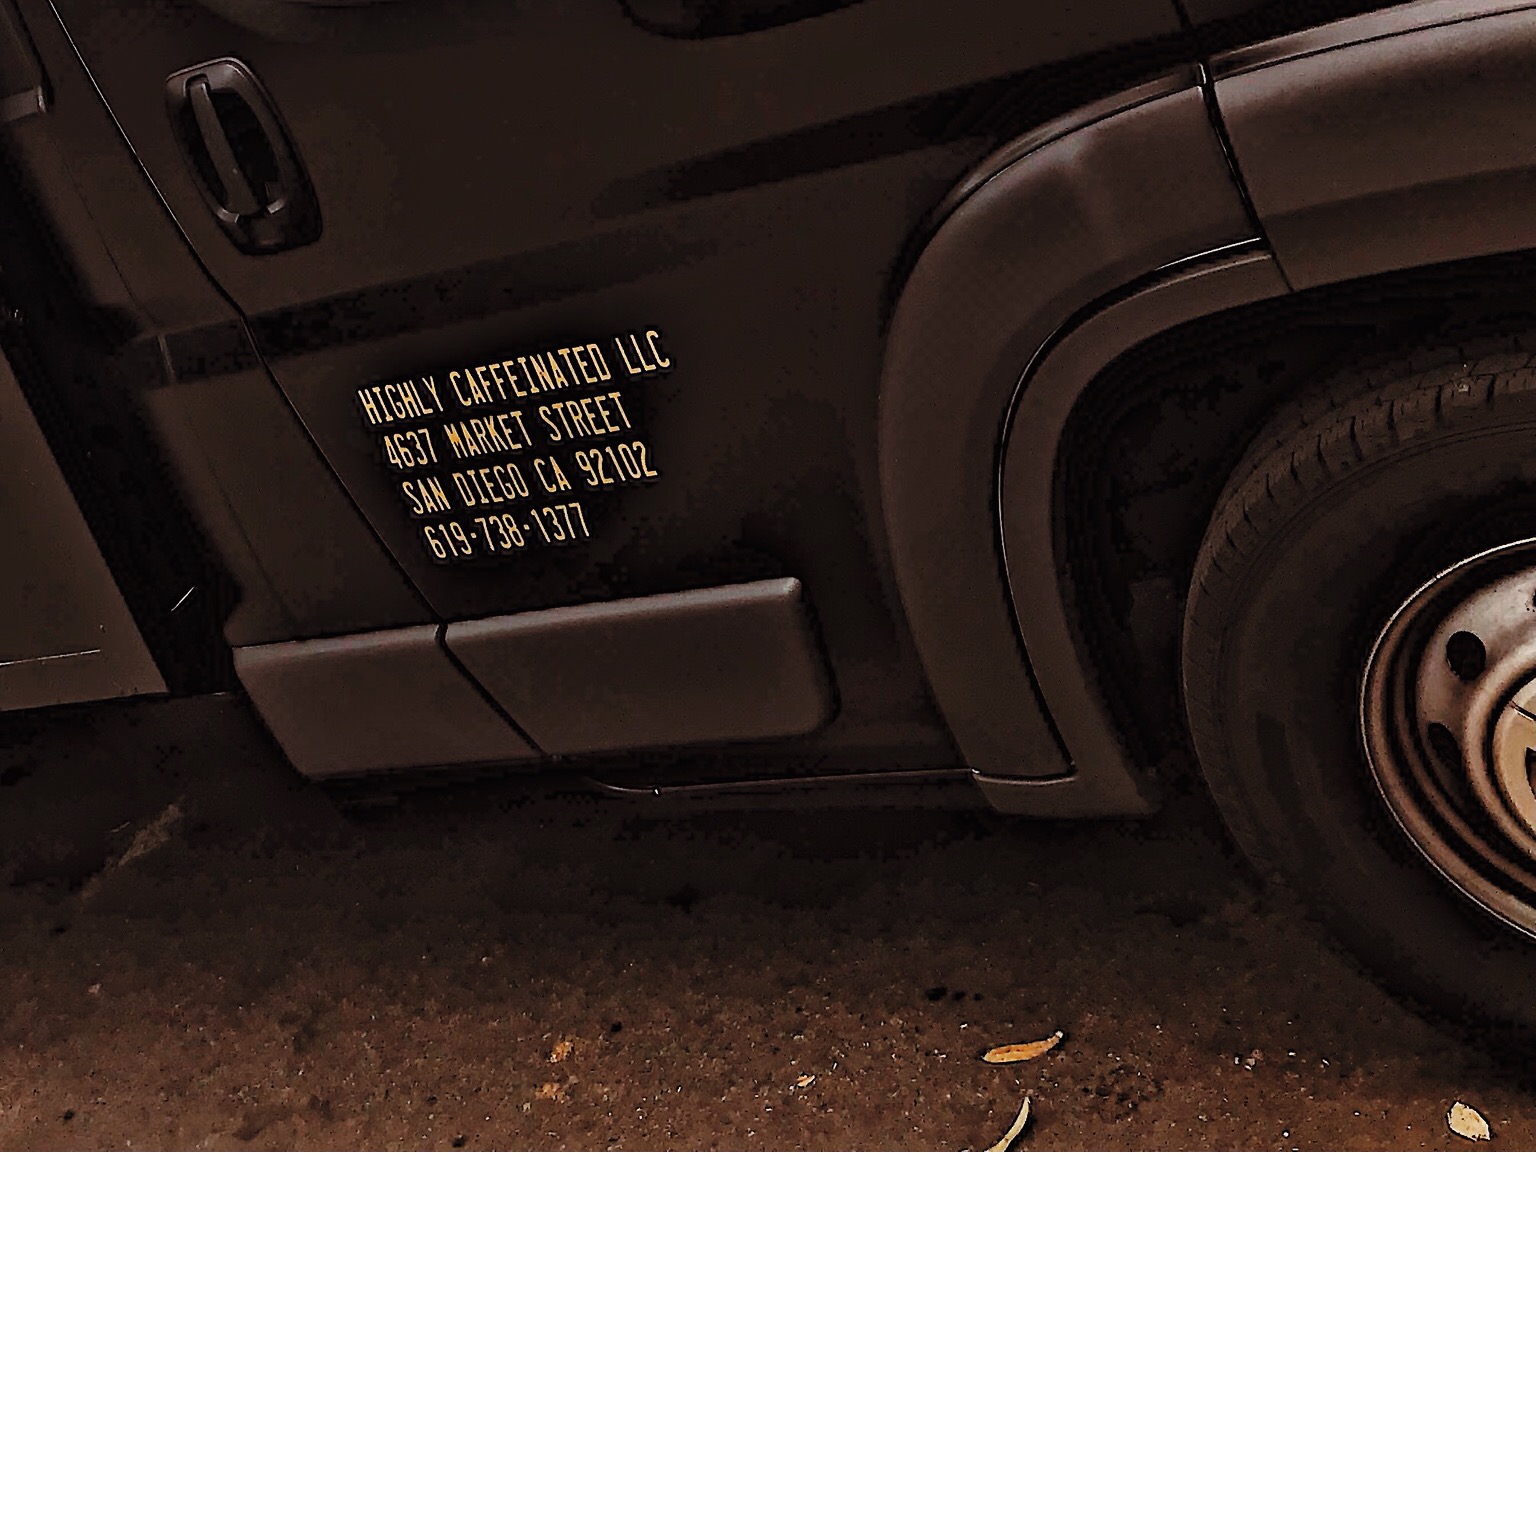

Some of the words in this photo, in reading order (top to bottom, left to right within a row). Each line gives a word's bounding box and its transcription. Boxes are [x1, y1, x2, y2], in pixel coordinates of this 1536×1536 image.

[357, 375, 444, 425] HIGHLY
[449, 343, 611, 407] CAFFEINATED
[615, 330, 671, 375] LLC
[383, 428, 438, 469] 4637
[443, 410, 532, 459] MARKET
[539, 391, 631, 441] STREET
[402, 476, 451, 514] SAN
[452, 462, 530, 507] DIEGO
[534, 456, 572, 493] CA
[575, 441, 658, 486] 92102
